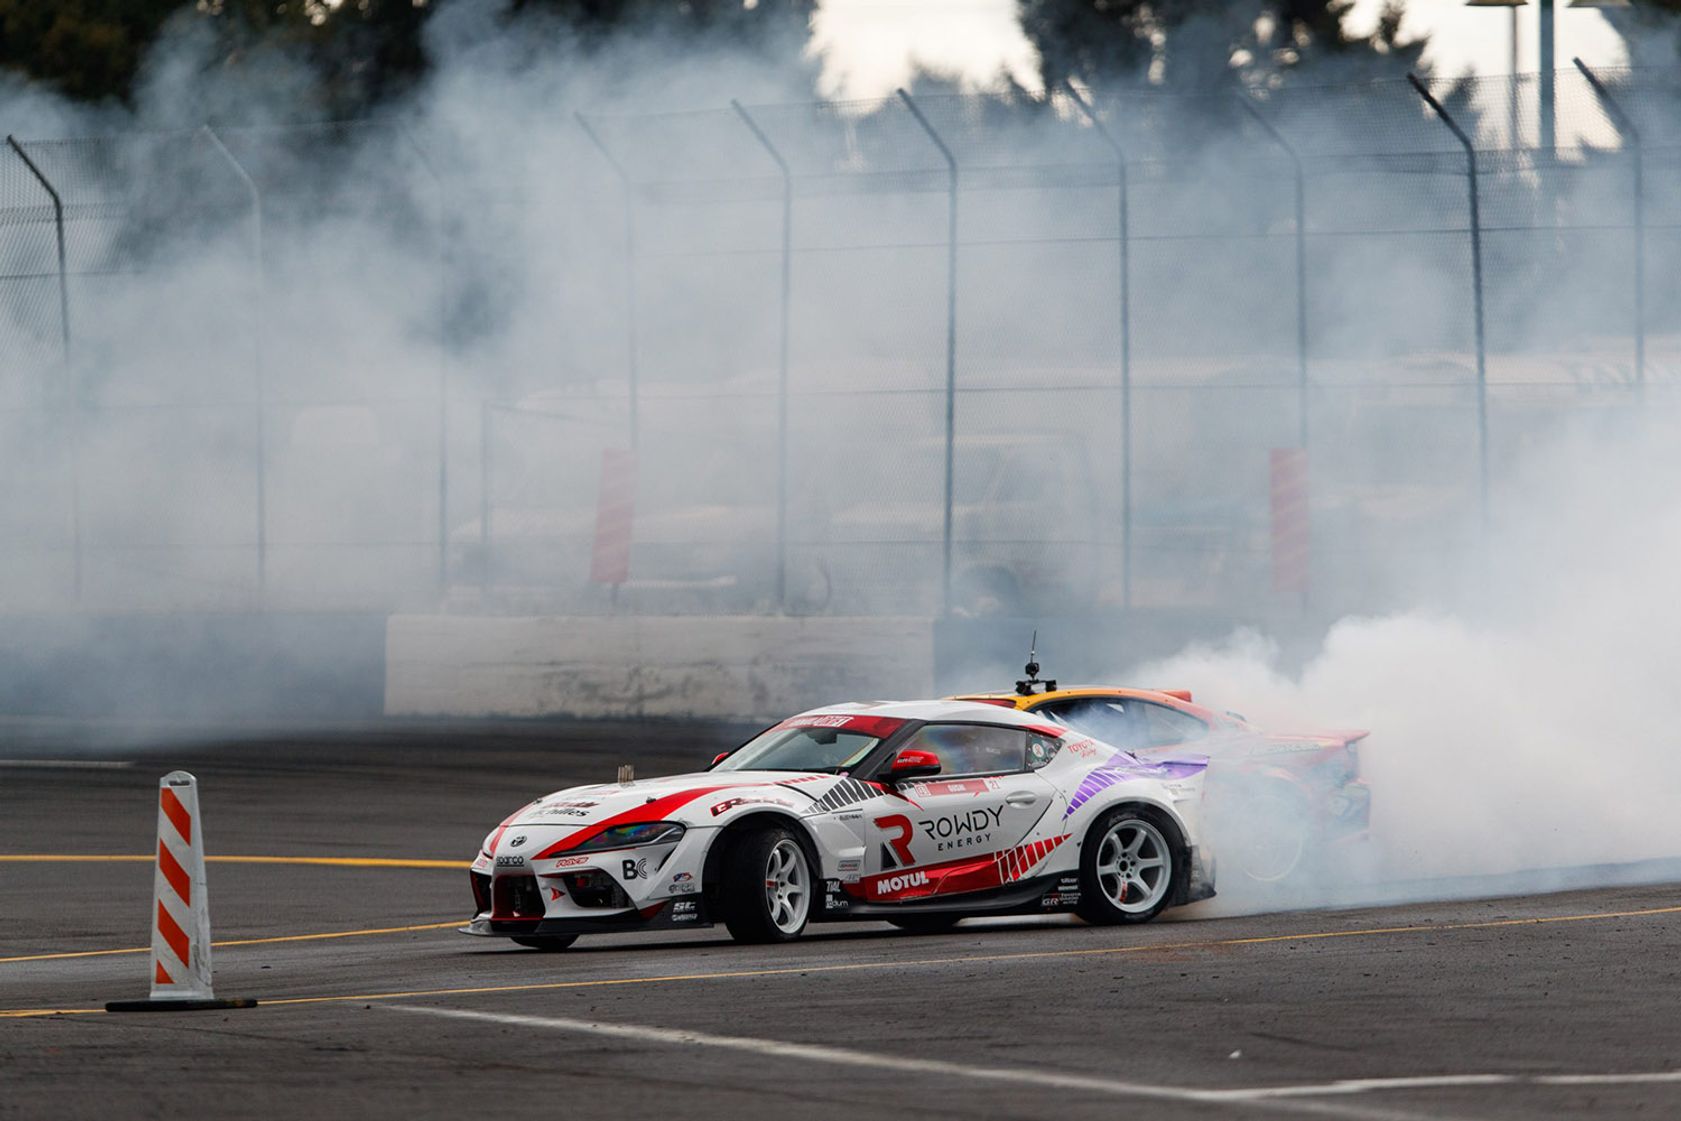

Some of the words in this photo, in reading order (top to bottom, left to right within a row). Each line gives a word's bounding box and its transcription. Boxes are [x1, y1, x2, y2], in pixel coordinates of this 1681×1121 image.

[918, 805, 1004, 840] ROWDY
[937, 832, 992, 851] ENERGY
[877, 871, 930, 895] MOTUL
